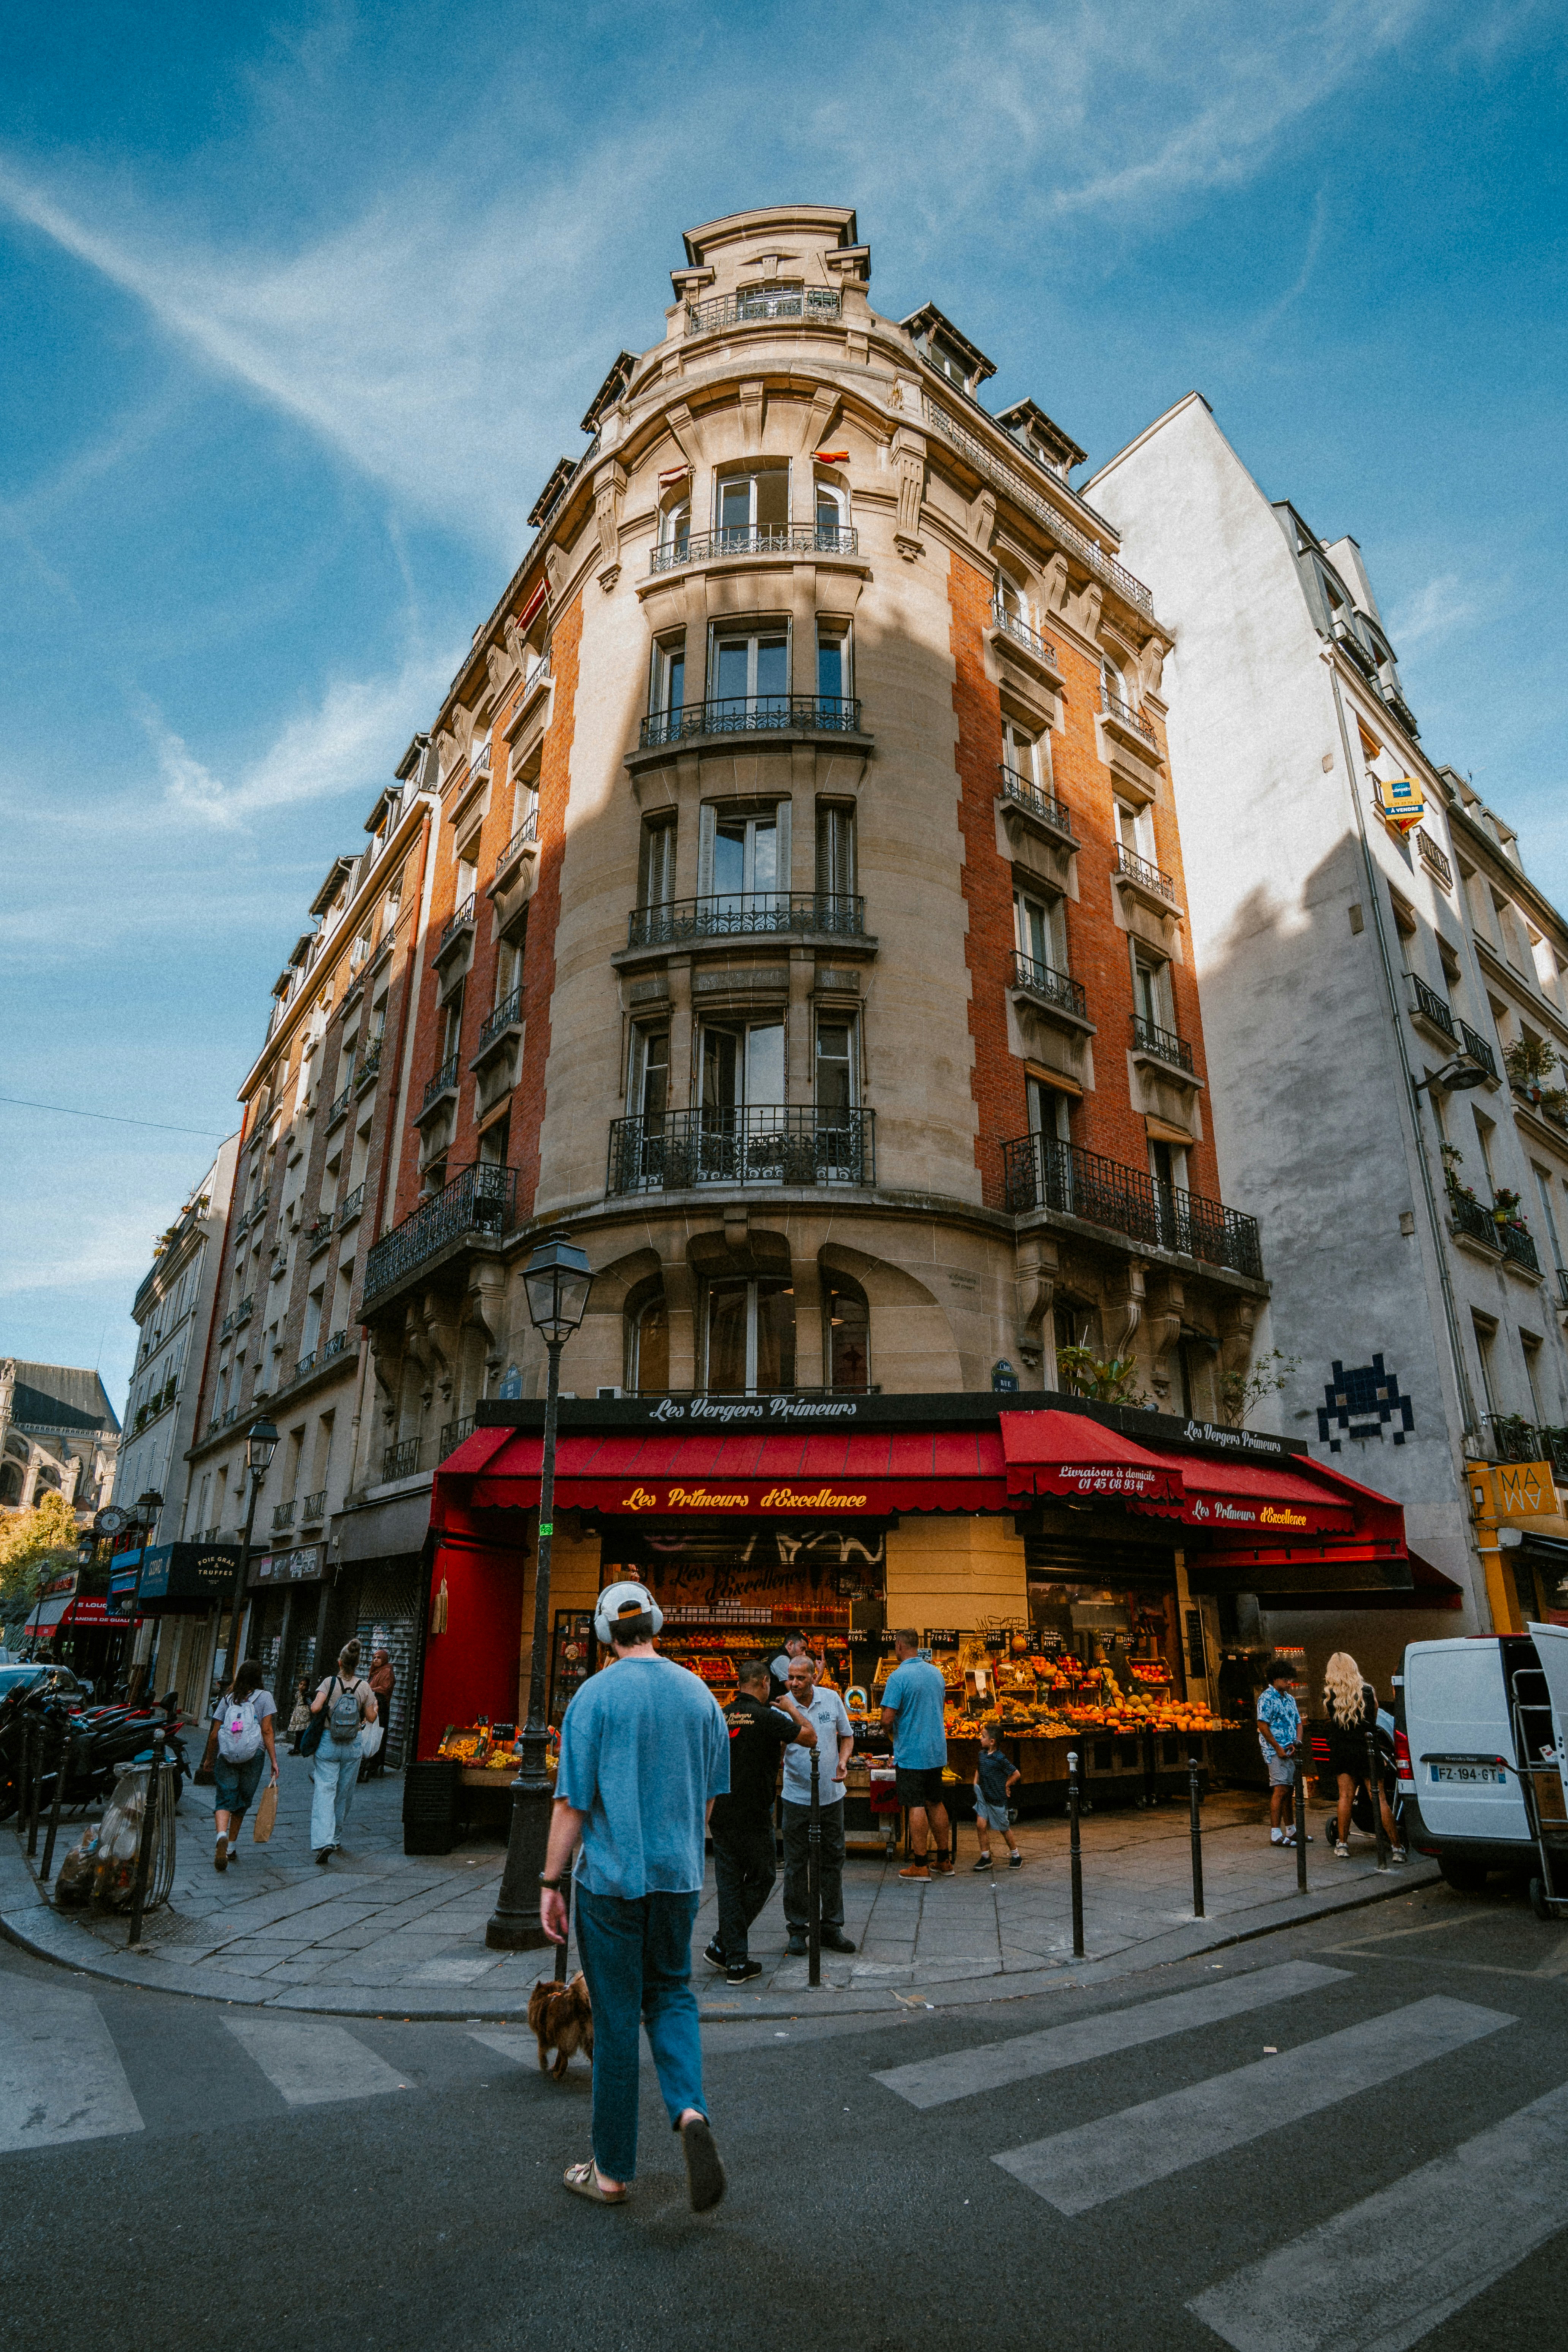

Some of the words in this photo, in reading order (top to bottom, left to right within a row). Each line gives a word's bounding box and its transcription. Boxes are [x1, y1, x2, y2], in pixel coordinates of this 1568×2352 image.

[649, 1399, 684, 1421] Les
[691, 1399, 763, 1422] Vergers
[770, 1398, 857, 1416] Primeurs
[1184, 1421, 1202, 1441] Les
[1204, 1424, 1240, 1446] Vergers
[1242, 1431, 1281, 1452] Primeurs
[1059, 1466, 1114, 1478] Livraison
[1116, 1467, 1123, 1477] à
[1125, 1468, 1155, 1481] domicile
[1078, 1478, 1091, 1489] 01
[1093, 1478, 1106, 1489] 45
[1109, 1478, 1122, 1489] 08
[1124, 1479, 1135, 1490] 93
[1136, 1481, 1144, 1491] 44
[622, 1488, 656, 1510] Les
[668, 1488, 749, 1507] Primeurs
[760, 1488, 867, 1508] d'Excellence
[1192, 1500, 1209, 1520] Les
[1215, 1502, 1255, 1521] Primeurs
[1260, 1507, 1307, 1526] d'Excellence
[198, 1557, 215, 1566] FOIE
[217, 1557, 236, 1567] GRAS
